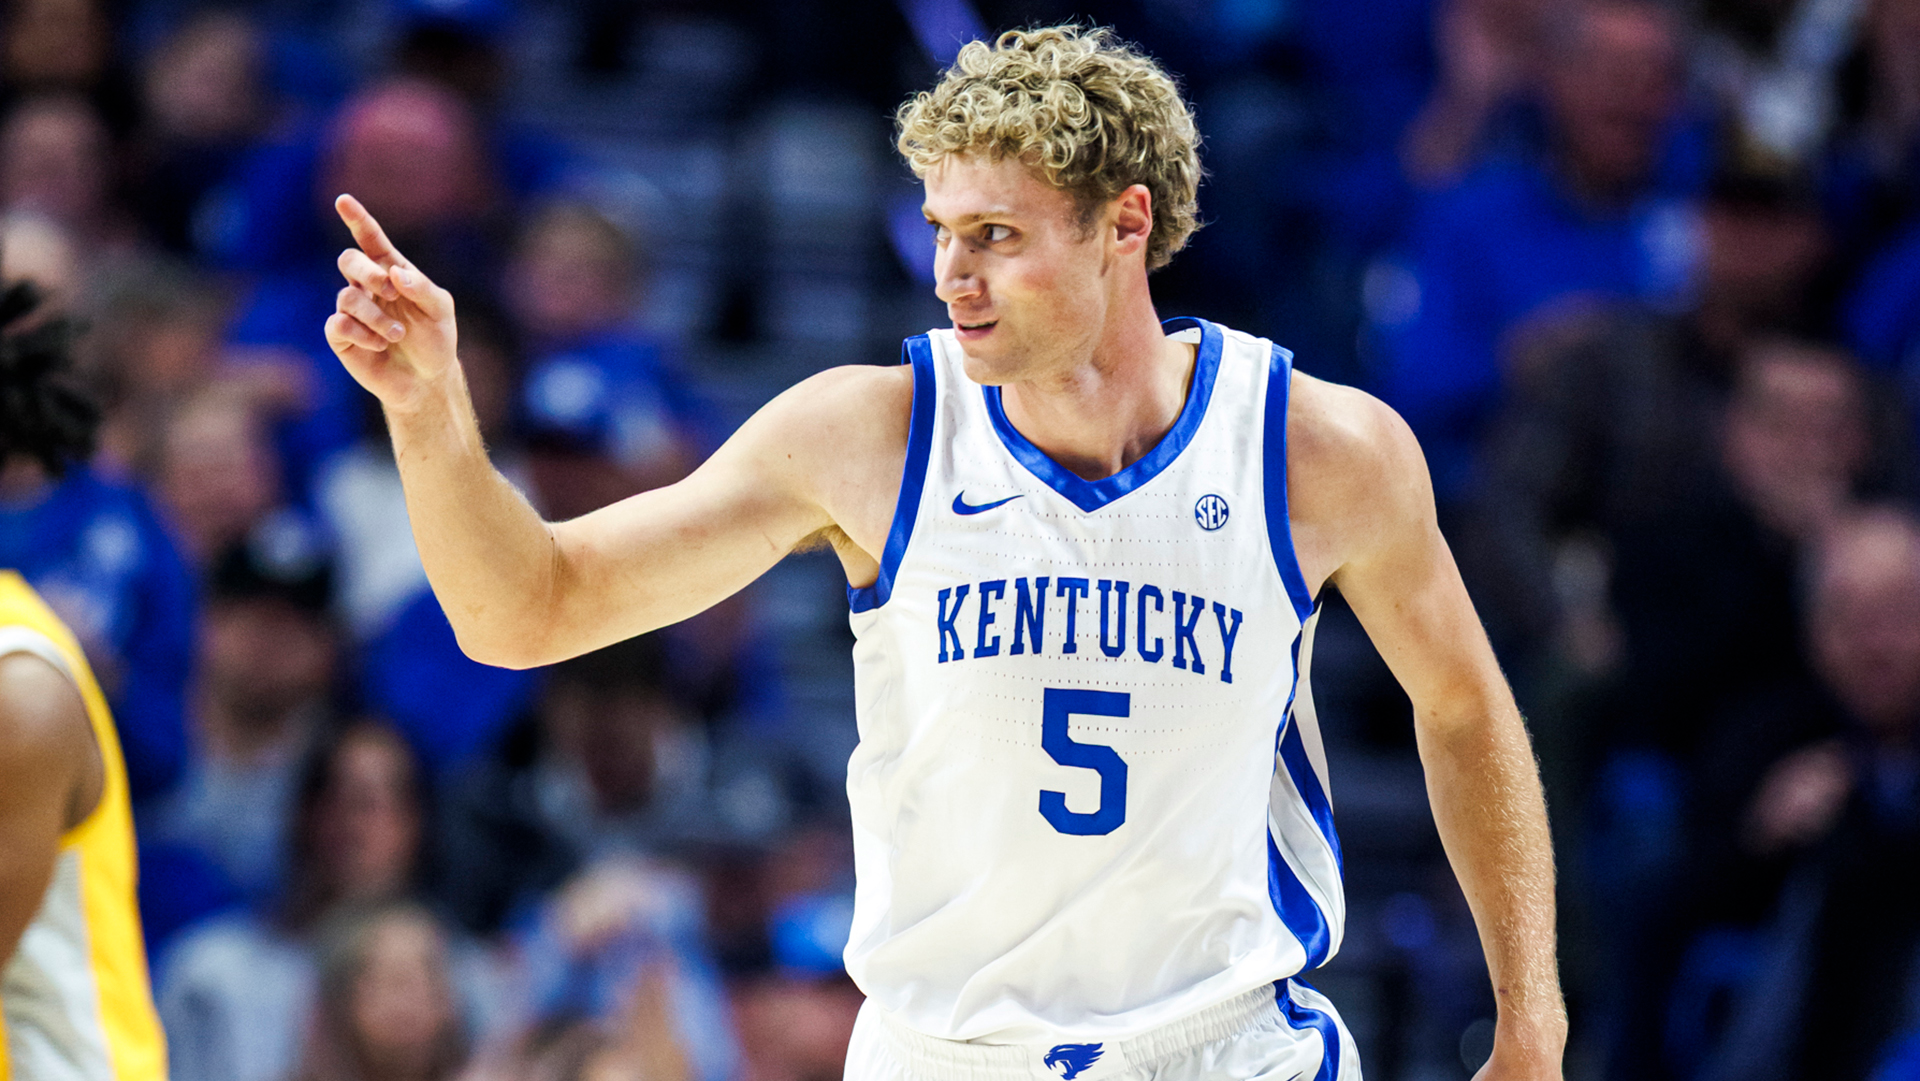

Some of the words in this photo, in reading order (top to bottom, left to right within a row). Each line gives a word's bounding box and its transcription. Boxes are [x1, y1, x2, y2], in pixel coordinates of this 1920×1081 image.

[1196, 495, 1227, 529] SEC
[937, 576, 1243, 684] KENTUCKY
[1038, 687, 1131, 836] 5
